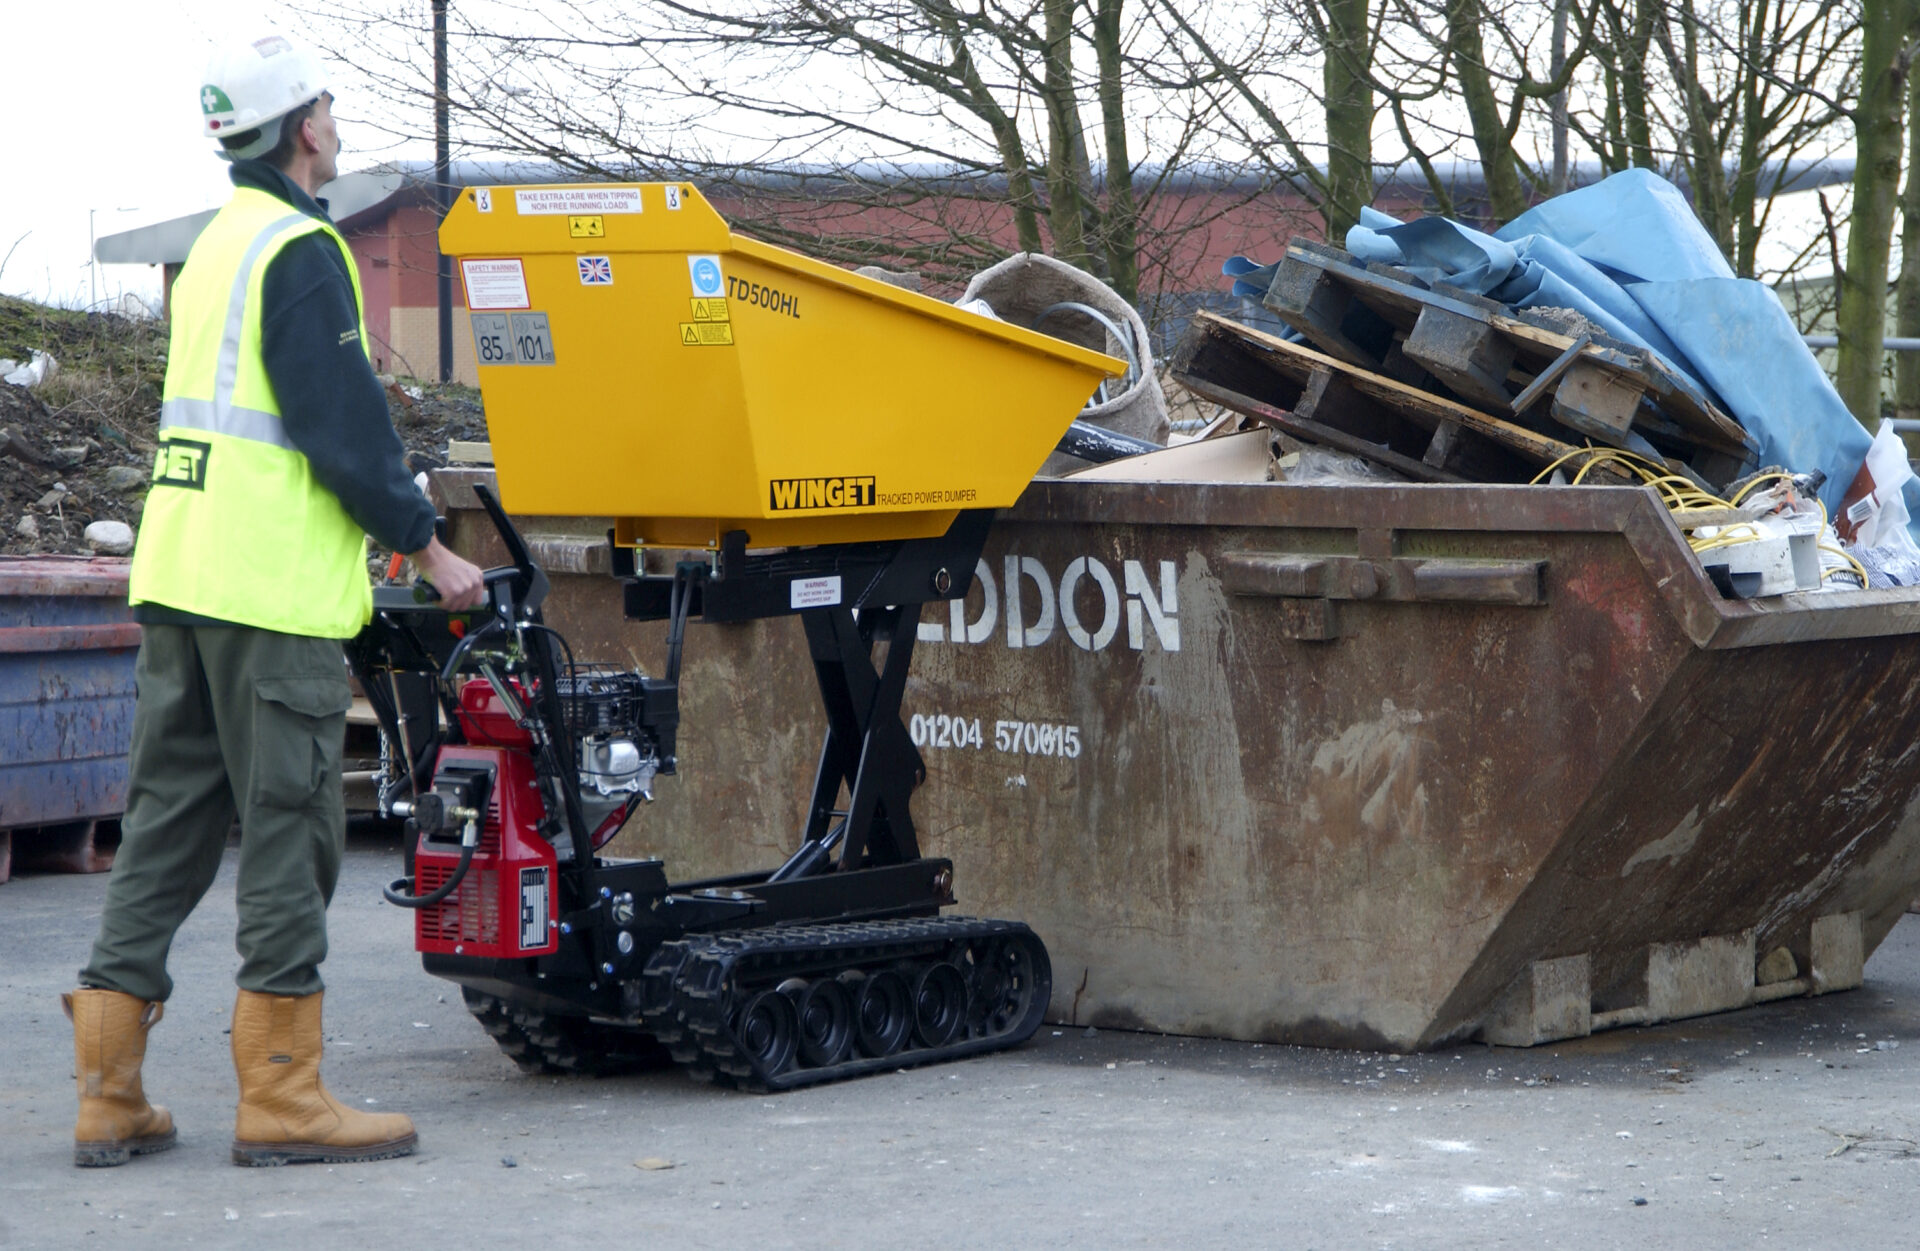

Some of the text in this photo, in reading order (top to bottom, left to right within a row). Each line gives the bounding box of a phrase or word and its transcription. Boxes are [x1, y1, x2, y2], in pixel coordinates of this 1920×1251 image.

[519, 191, 639, 201] TAKE EXTRA CARE WHEN TIPPING
[531, 200, 629, 211] NON FREE RUNNING LOADS
[467, 265, 489, 273] SAFETY
[728, 275, 801, 319] TD500HL
[480, 335, 504, 361] 85
[517, 335, 545, 361] 101
[771, 477, 976, 509] WINGET TRACKED POWER DUMPER
[917, 554, 1181, 652] DDON
[910, 713, 983, 750] 01204
